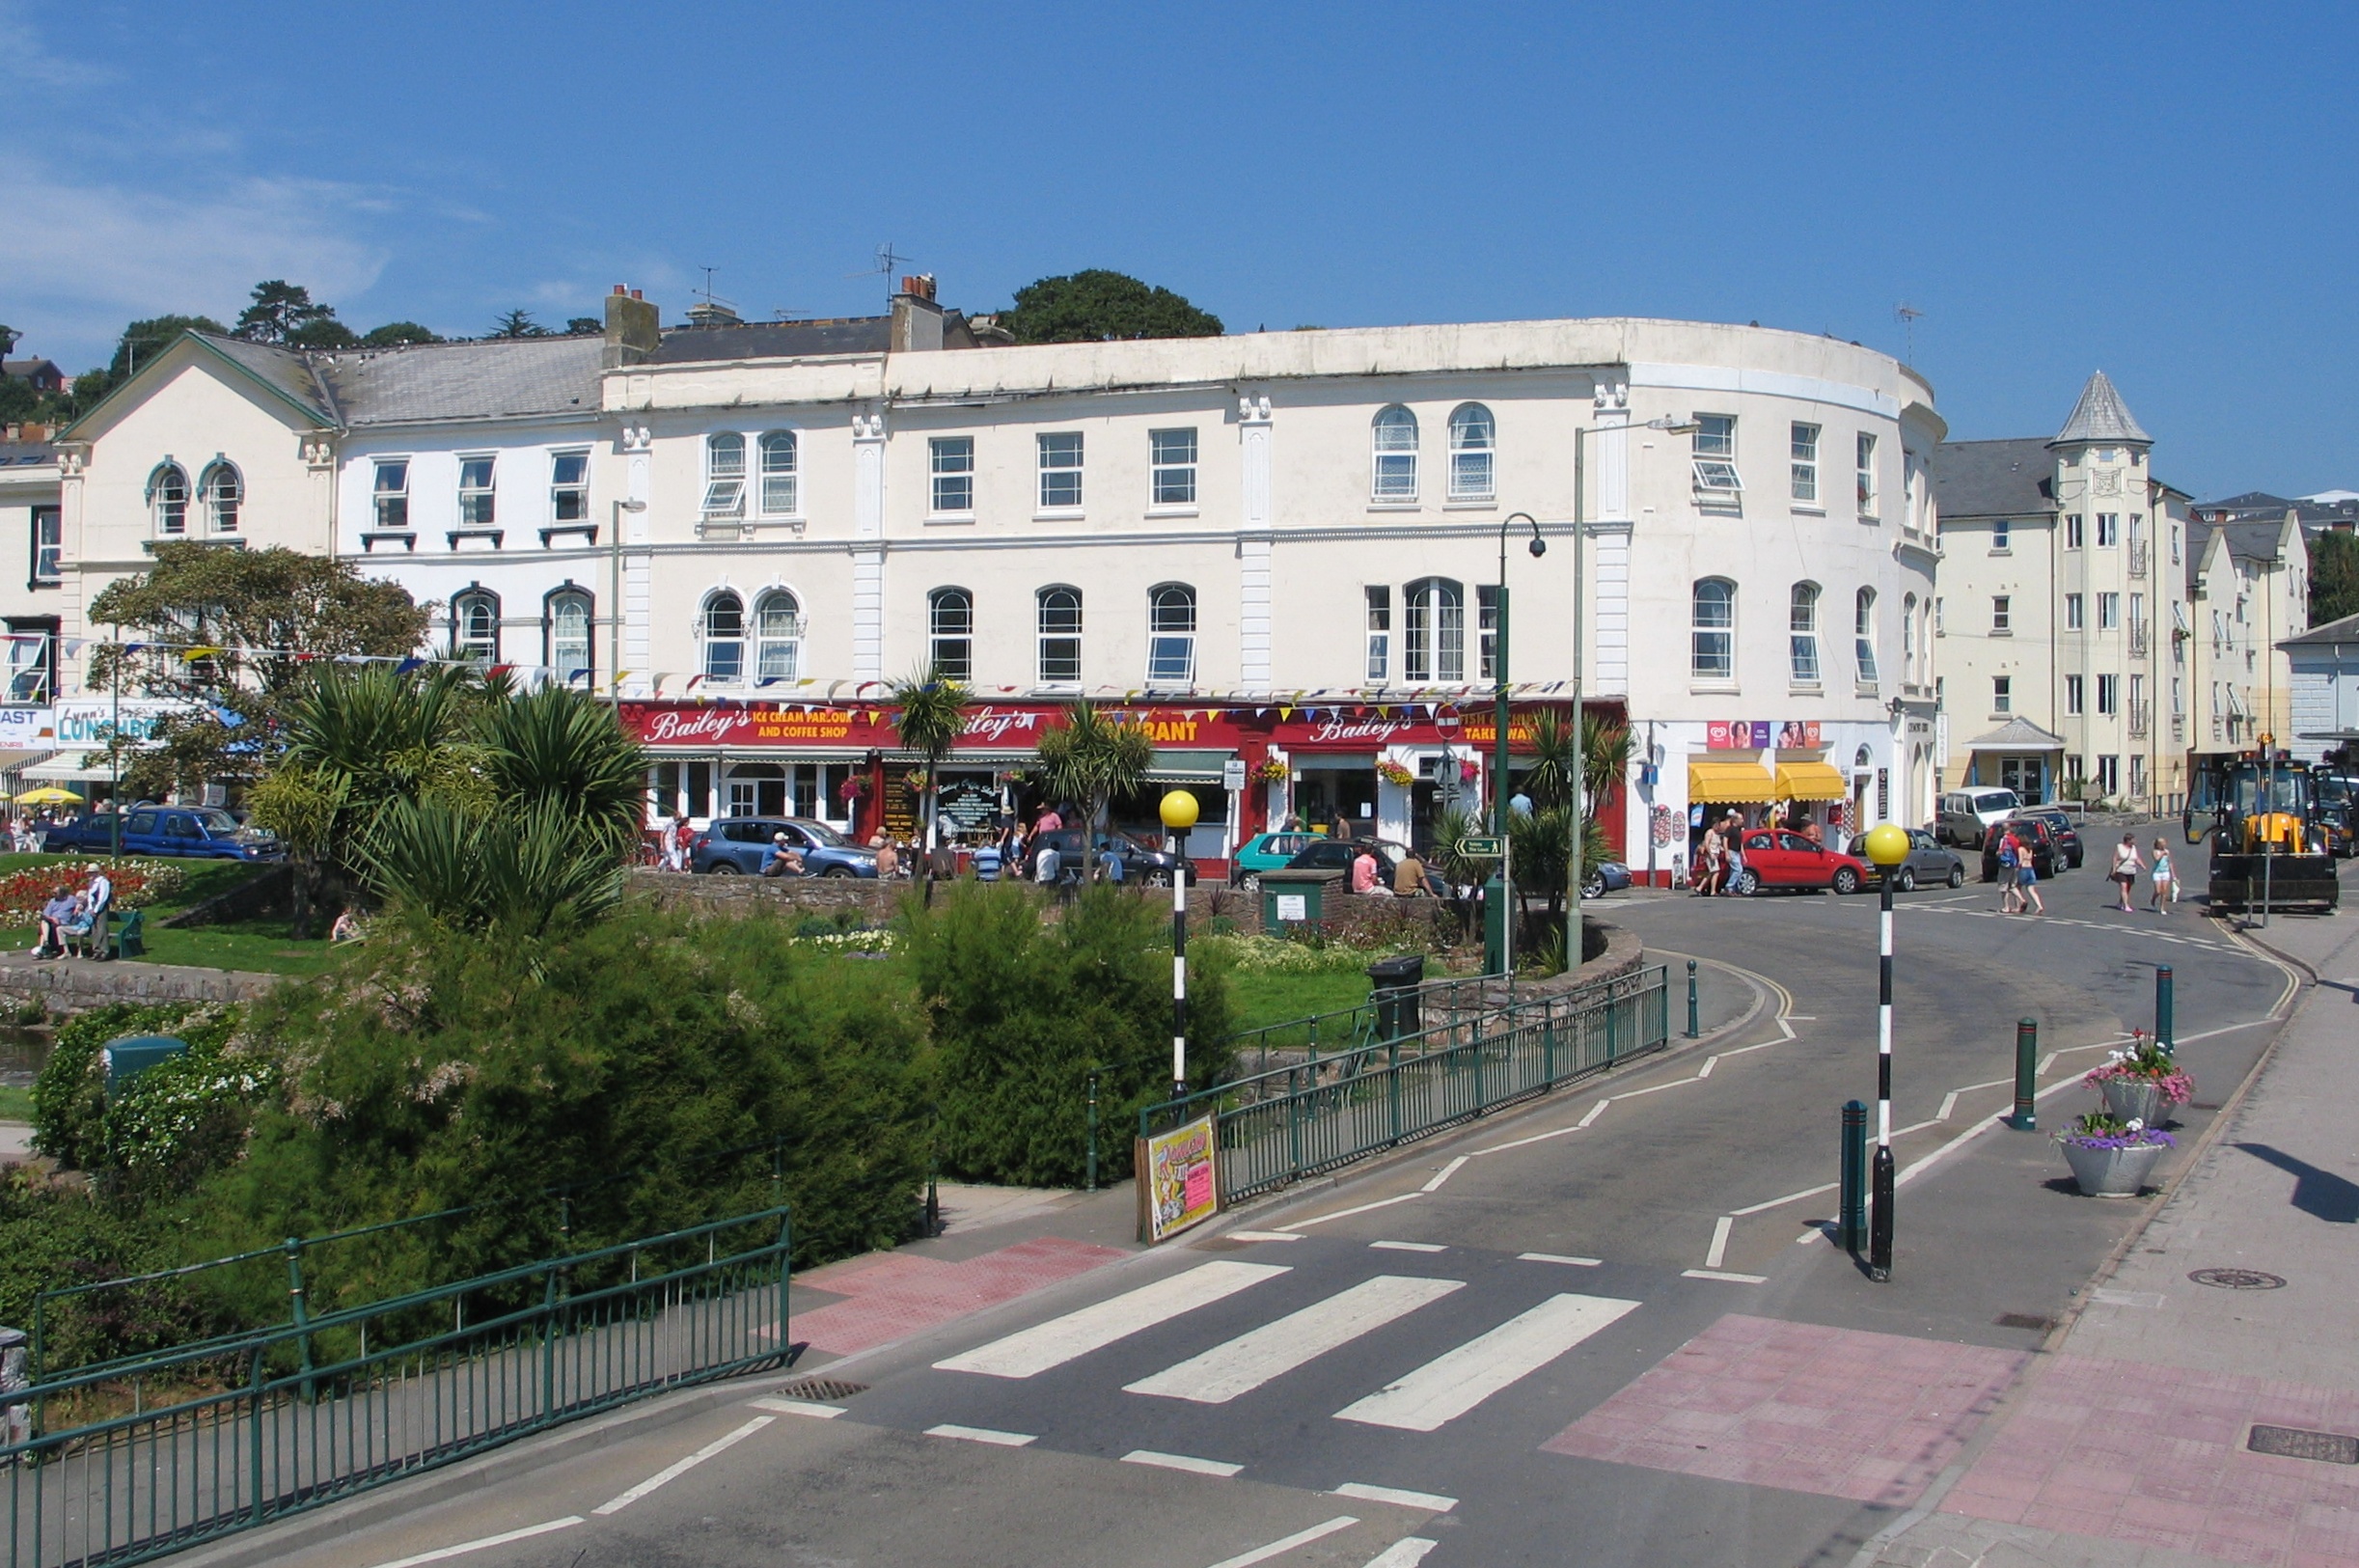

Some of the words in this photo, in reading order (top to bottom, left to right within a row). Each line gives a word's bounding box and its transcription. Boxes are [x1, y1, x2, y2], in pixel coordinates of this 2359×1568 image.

[63, 707, 105, 724] Lynn's
[645, 706, 752, 741] Bailey's
[753, 712, 767, 723] ICE
[770, 712, 804, 723] CREAM
[1460, 713, 1486, 725] FISH
[757, 727, 781, 737] AND
[782, 727, 817, 737] COFFEE
[820, 727, 847, 737] SHOP
[1309, 713, 1414, 742] Bailey's
